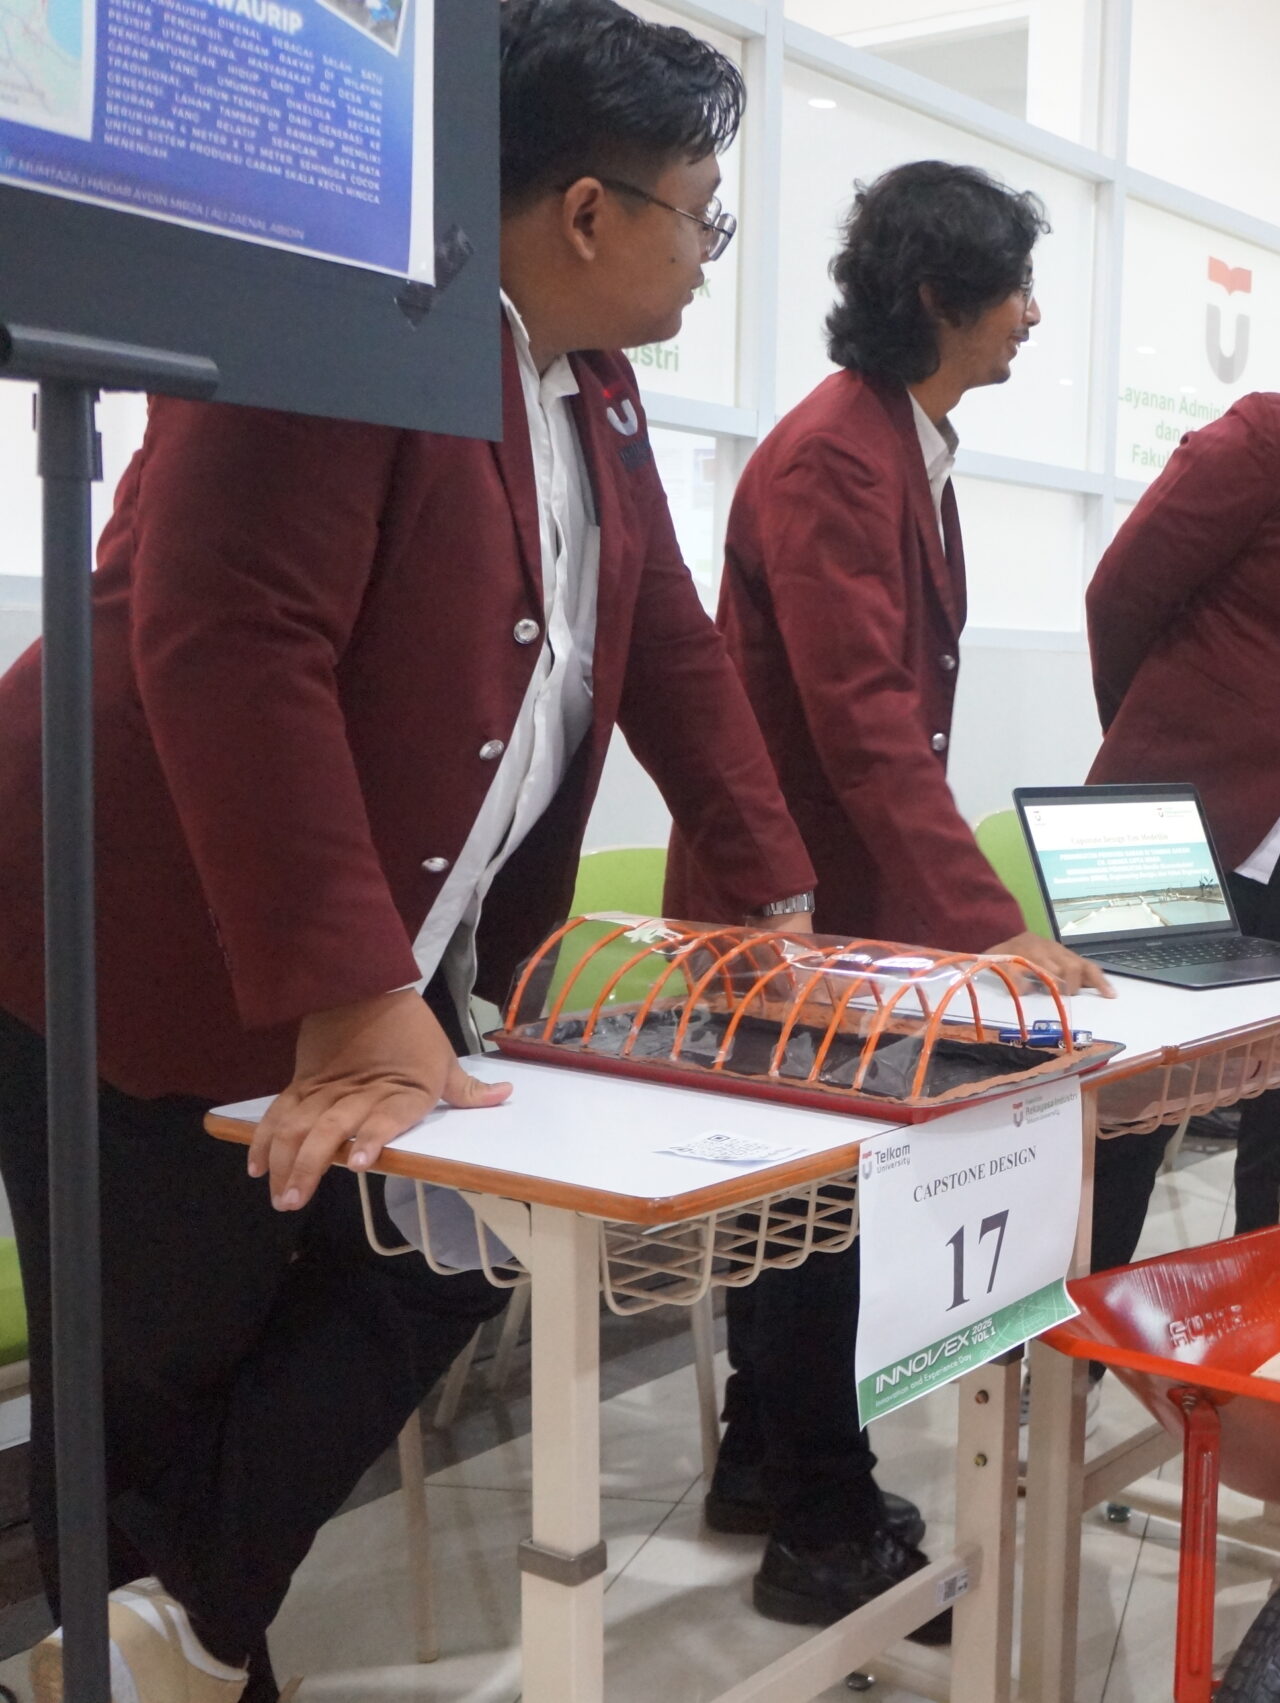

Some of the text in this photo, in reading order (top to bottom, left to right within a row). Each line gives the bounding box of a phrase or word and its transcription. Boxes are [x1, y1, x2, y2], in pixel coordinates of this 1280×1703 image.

[108, 7, 151, 31] PESISIR
[162, 27, 197, 47] UTARA
[208, 42, 236, 60] JAWA
[248, 56, 311, 86] MASYARAKAT
[320, 81, 330, 93] DI
[338, 87, 362, 104] DESA
[108, 23, 381, 124] MENGGANTUNGKAN HIDUP DARI USAHA TAMBAK
[163, 11, 222, 40] PENGHASIL
[232, 36, 269, 57] GARAM
[279, 53, 315, 73] RAKYAT
[324, 69, 334, 80] DI
[343, 77, 382, 97] WILAYAH
[218, 15, 261, 41] DIKENAL
[322, 54, 352, 73] SALAH
[107, 40, 381, 137] GARAM YANG UMUMNYA DIKELOLA SECARA
[107, 71, 163, 97] GENERASI
[175, 92, 211, 112] LAHAN
[220, 104, 260, 126] TAMBAK
[268, 119, 278, 132] DI
[286, 126, 335, 149] RAWAURIP
[107, 86, 155, 109] UKURAN
[171, 105, 199, 124] YANG
[217, 119, 256, 139] RELATIF
[272, 136, 318, 158] SERAGAM
[108, 55, 181, 88] TRADISIONAL
[193, 81, 229, 101] TURUN
[233, 94, 281, 118] TEMURUN
[288, 112, 312, 128] DARI
[318, 121, 363, 144] GENERASI
[104, 132, 168, 159] MENENGAH
[105, 118, 381, 205] UNTUK SISTEM PRODUKSI GARAM SKALA KECIL HINGGA
[106, 101, 175, 130] BERUKURAN
[192, 126, 228, 146] METER
[260, 147, 293, 164] METER
[300, 159, 346, 180] SEHINGGA
[350, 174, 380, 191] COCOK
[875, 1144, 911, 1165] Telkom
[876, 1156, 911, 1174] University
[913, 1145, 1037, 1203] CAPSTONE DESIGN
[945, 1209, 1010, 1312] 17
[971, 1317, 993, 1335] 2025
[971, 1326, 996, 1345] VOL 1
[875, 1330, 970, 1395] INNOVEX
[910, 1376, 924, 1389] and
[924, 1360, 958, 1381] Experience
[958, 1353, 972, 1366] Day
